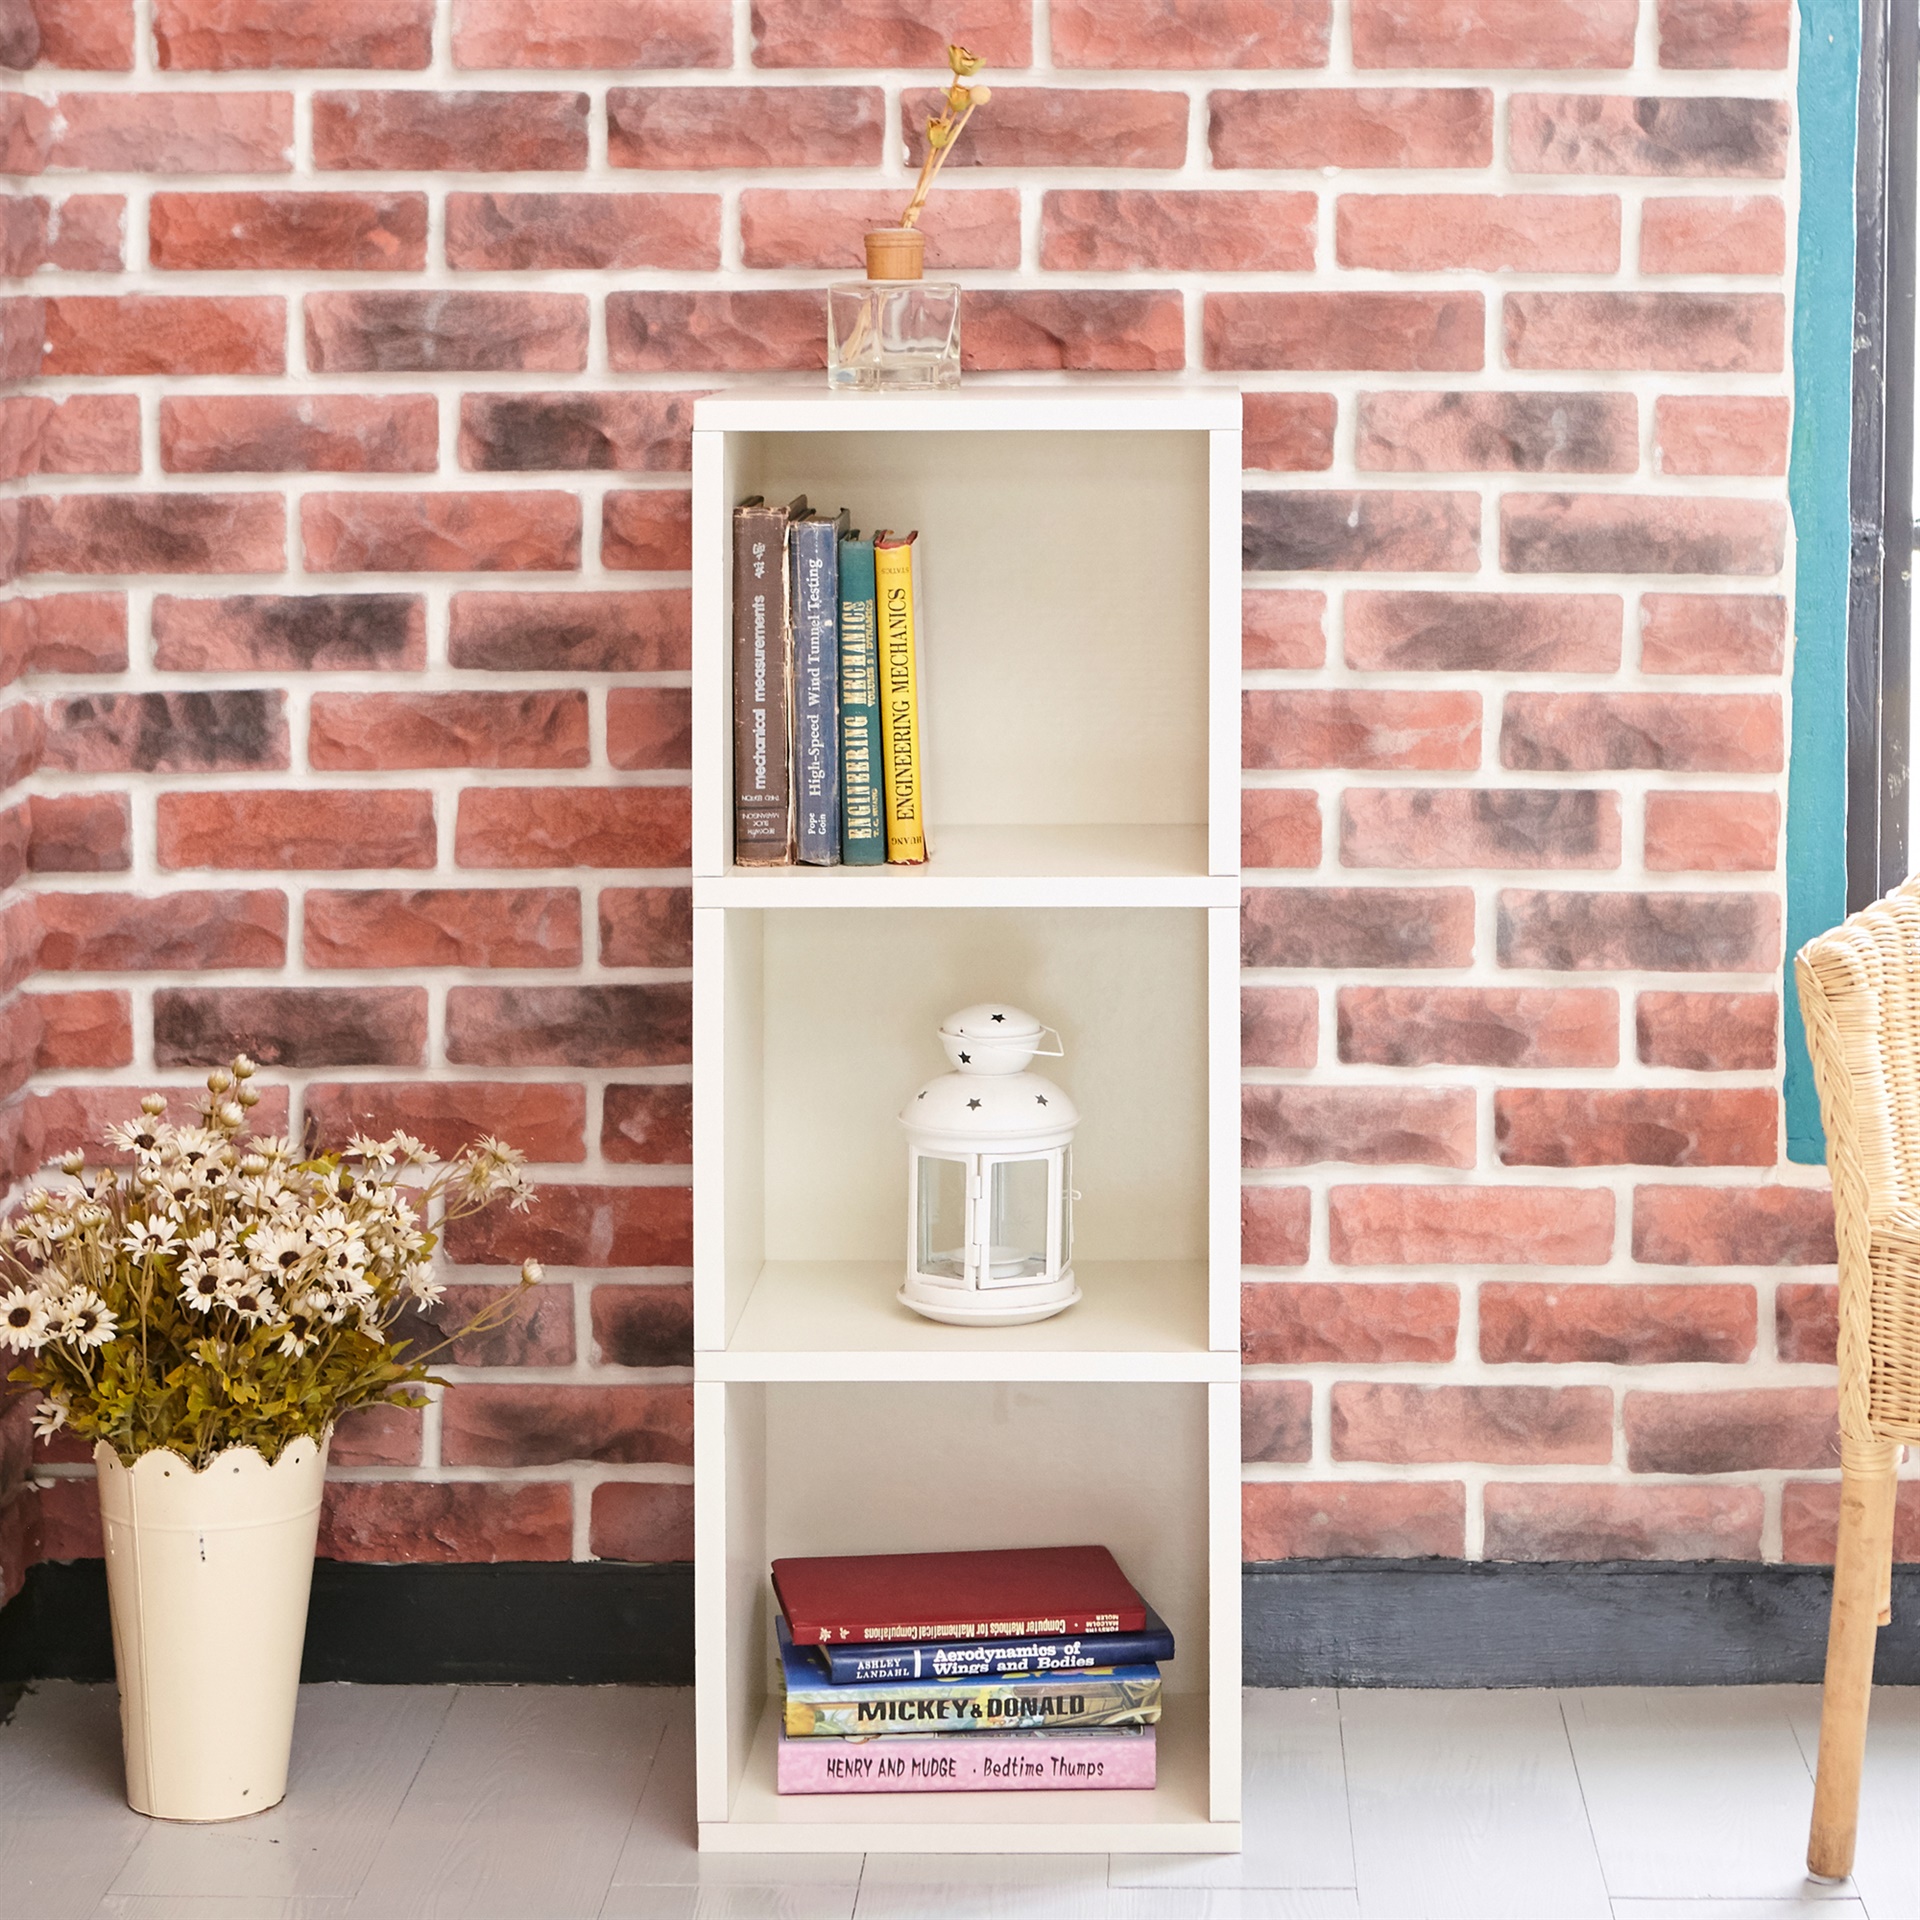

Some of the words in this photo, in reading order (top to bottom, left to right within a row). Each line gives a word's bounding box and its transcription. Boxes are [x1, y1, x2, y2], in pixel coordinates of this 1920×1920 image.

[880, 566, 910, 575] STATICS
[806, 558, 824, 612] Testing
[865, 598, 875, 650] DYNAMICS
[752, 594, 766, 702] measurements
[807, 614, 820, 665] Tunnel
[887, 587, 910, 694] MECHANICS
[841, 601, 868, 705] MECHANICS
[807, 667, 820, 707] Wind
[866, 666, 876, 708] VOLUME
[752, 708, 766, 790] mechanical
[807, 714, 826, 797] High-Speed
[892, 699, 915, 821] ENGINEERING
[843, 715, 872, 840] ENGINEERING
[808, 812, 818, 836] Pope
[818, 813, 827, 836] Goin
[890, 835, 923, 846] HUANG
[863, 1625, 918, 1641] Computations
[918, 1623, 975, 1640] Mathematical
[976, 1622, 989, 1637] for
[990, 1619, 1025, 1636] Methods
[1025, 1618, 1067, 1634] Computer
[1085, 1620, 1120, 1628] MALCOLM
[857, 1658, 902, 1671] ASHLEY
[932, 1643, 1057, 1664] Aerodynamics
[1063, 1641, 1082, 1656] of
[855, 1667, 910, 1680] LANDAHL
[932, 1660, 990, 1675] Wings
[996, 1657, 1029, 1672] and
[1036, 1655, 1095, 1670] Bodies
[826, 1757, 873, 1779] HENRY
[877, 1756, 906, 1778] AND
[911, 1756, 957, 1778] MUDGE
[983, 1755, 1044, 1778] Bedtime
[1050, 1755, 1105, 1780] Thumps
